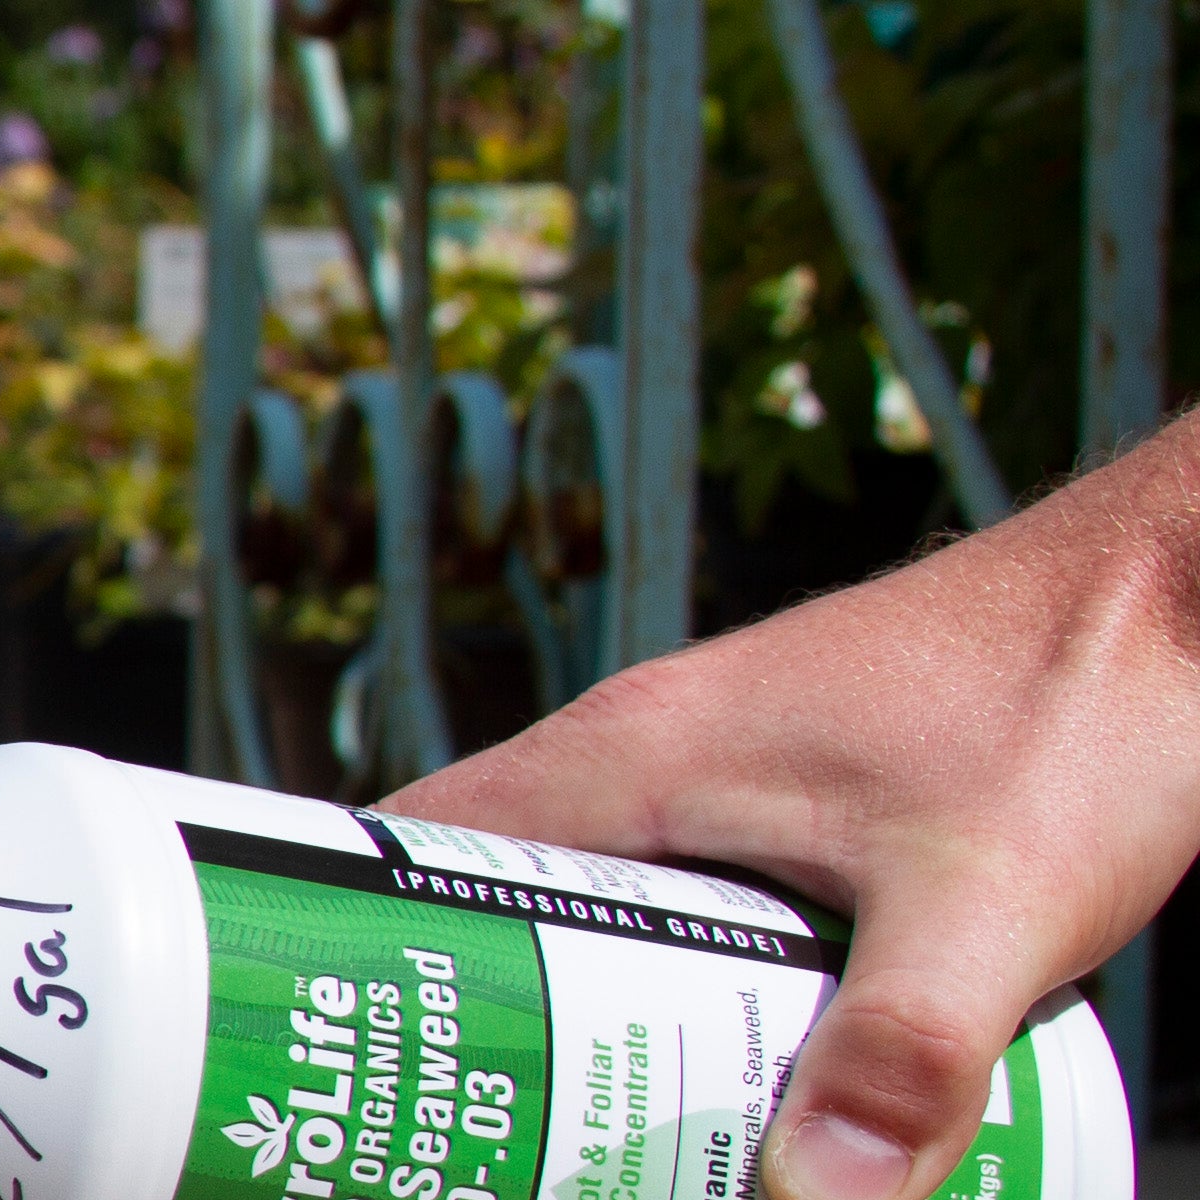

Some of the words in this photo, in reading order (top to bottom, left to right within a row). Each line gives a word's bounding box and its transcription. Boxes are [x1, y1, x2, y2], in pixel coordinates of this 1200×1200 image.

[350, 981, 401, 1184] ORGANICS
[582, 1038, 612, 1131] Foliar
[736, 987, 763, 1087] Seaweed,
[579, 1142, 608, 1166] &
[735, 1097, 766, 1200] Minerals,
